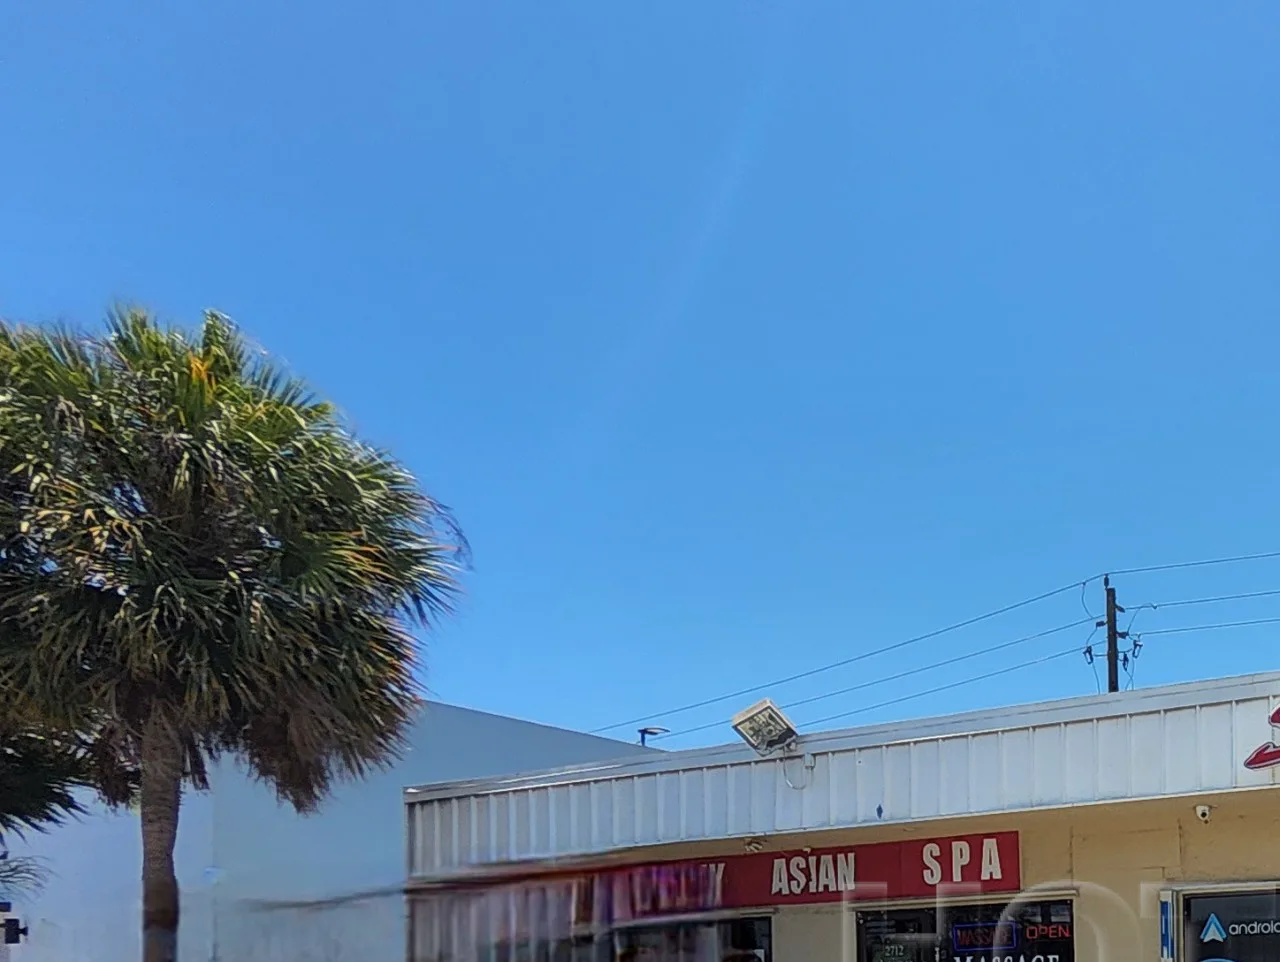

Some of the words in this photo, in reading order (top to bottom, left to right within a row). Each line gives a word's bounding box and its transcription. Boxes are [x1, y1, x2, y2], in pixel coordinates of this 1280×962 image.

[771, 852, 856, 896] ASIAN
[1026, 923, 1071, 940] OPEN
[884, 945, 904, 957] 2712
